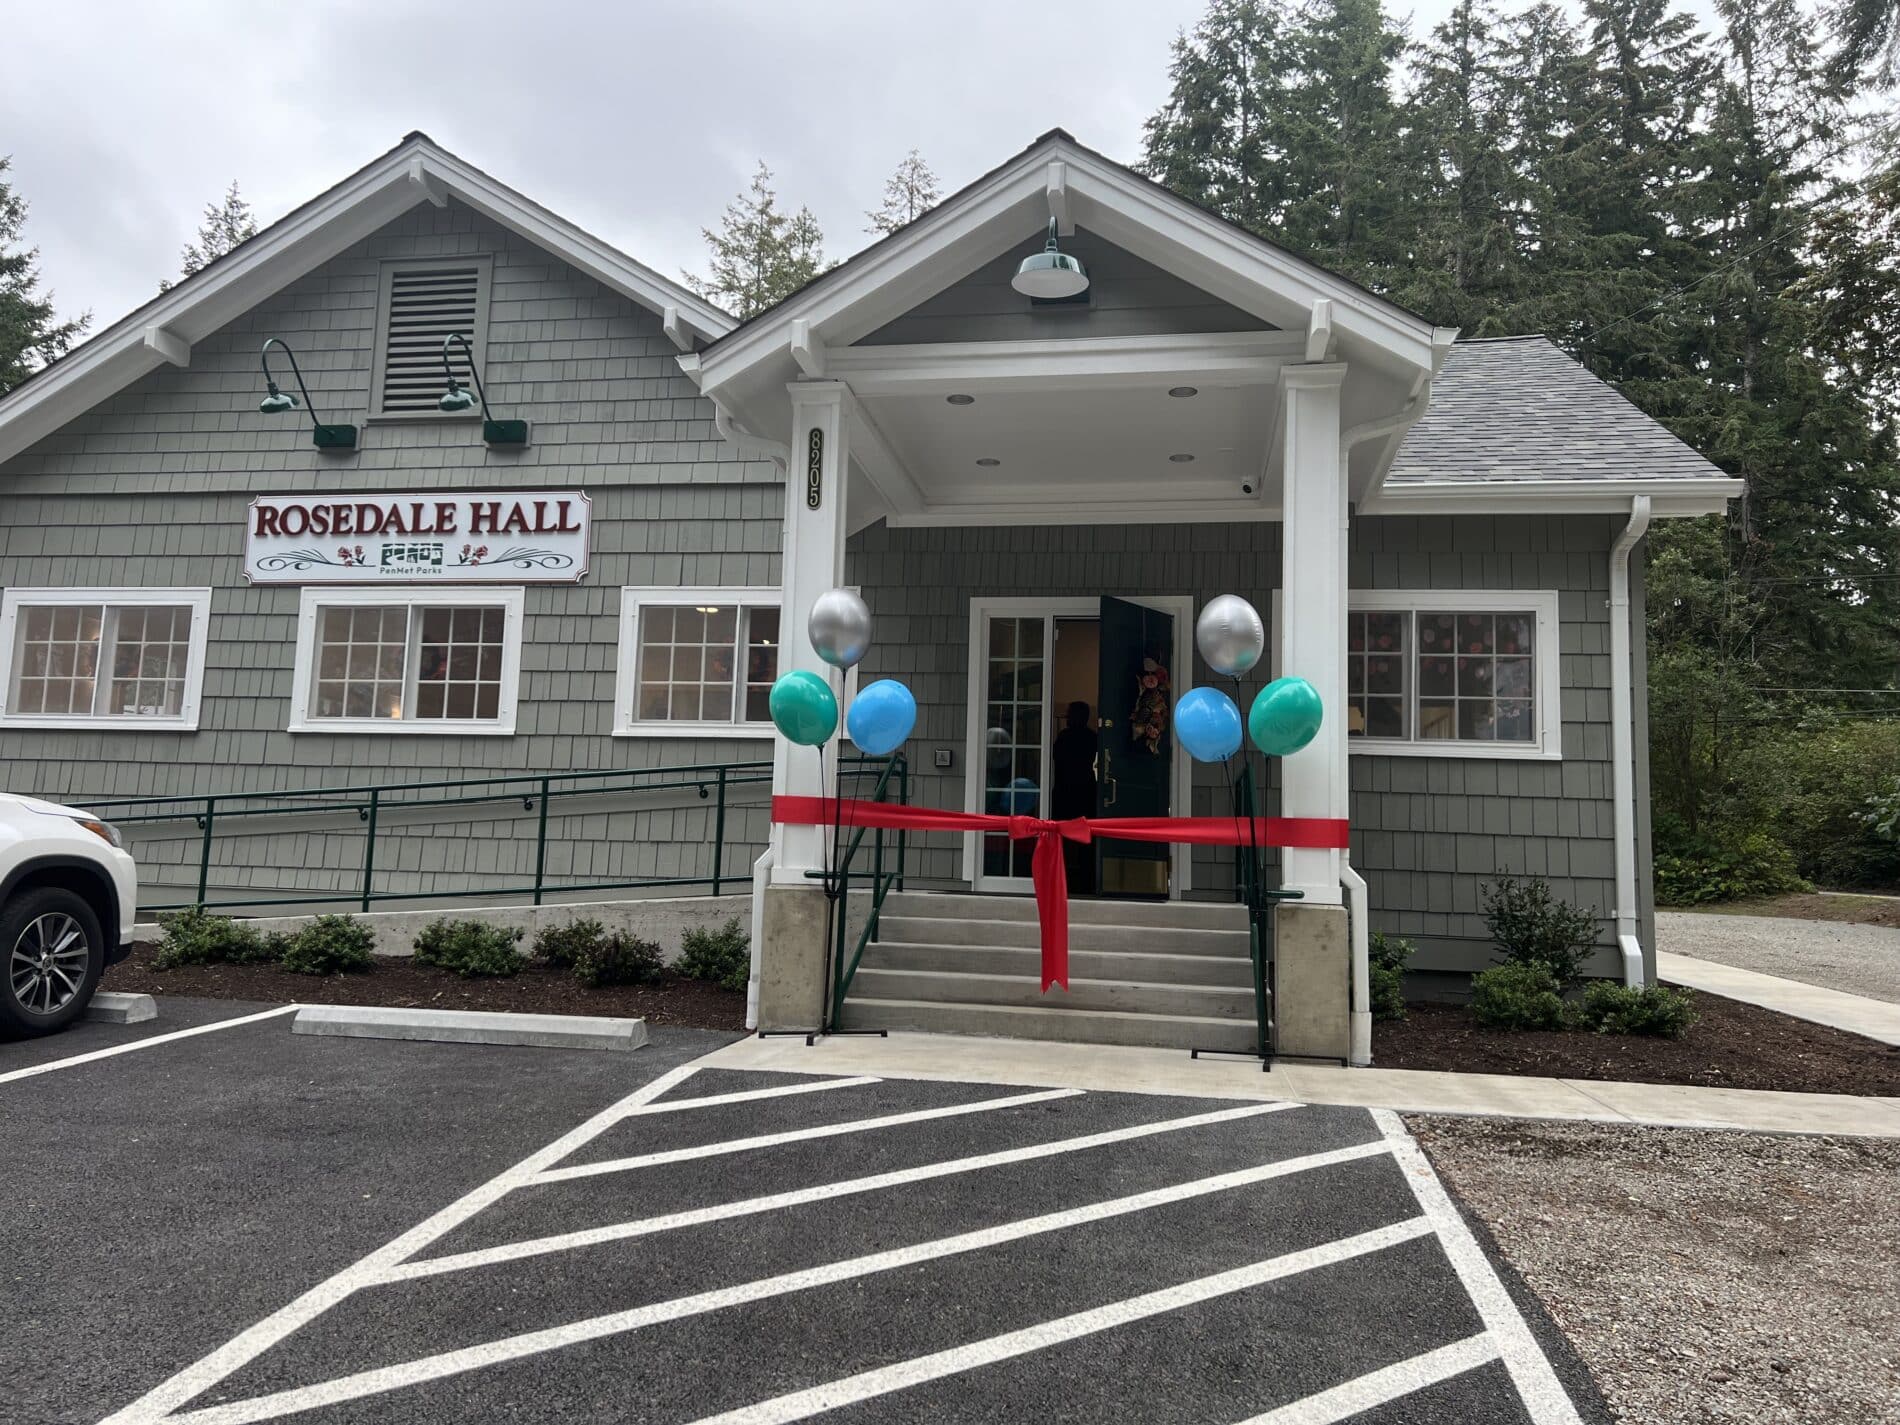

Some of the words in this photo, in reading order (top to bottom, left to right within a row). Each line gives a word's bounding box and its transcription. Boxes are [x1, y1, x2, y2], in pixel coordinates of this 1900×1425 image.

[809, 430, 821, 506] 8205
[254, 502, 458, 537] ROSEDALE
[469, 500, 581, 535] HALL
[379, 566, 414, 575] PenMet
[416, 566, 442, 575] Parks
